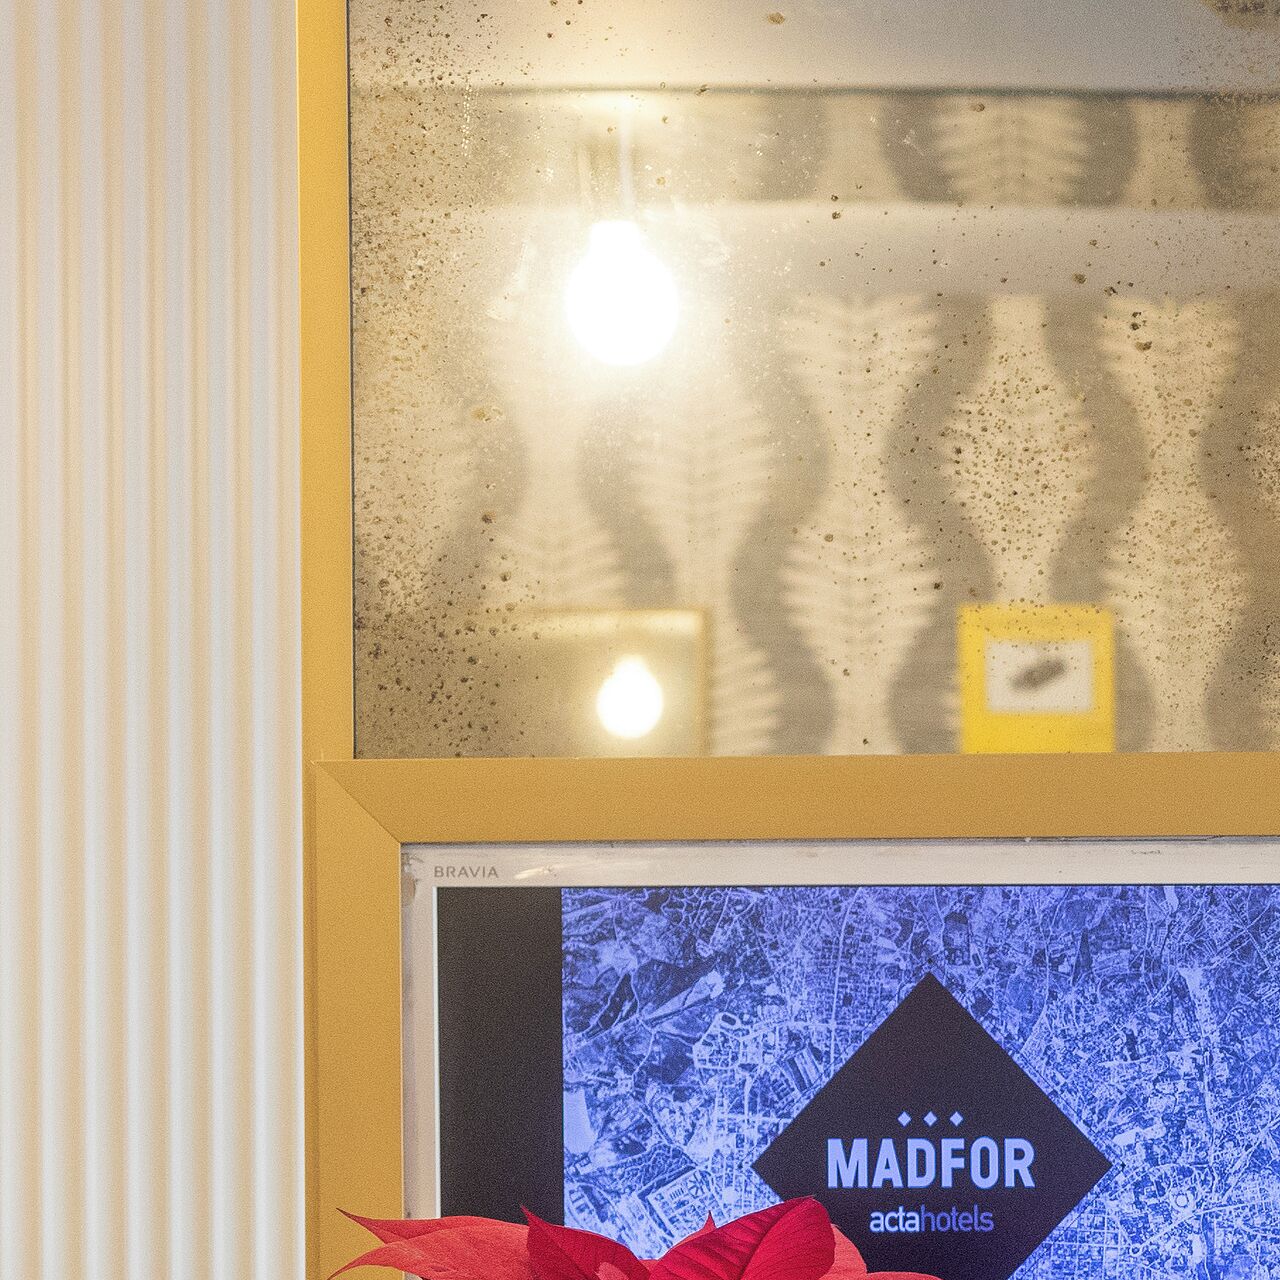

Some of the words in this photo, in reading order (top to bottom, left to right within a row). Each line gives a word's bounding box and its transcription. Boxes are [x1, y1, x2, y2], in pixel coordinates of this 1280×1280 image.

[433, 865, 500, 879] BRAVIA
[826, 1136, 1036, 1190] MADFOR
[869, 1204, 995, 1233] actahotels
